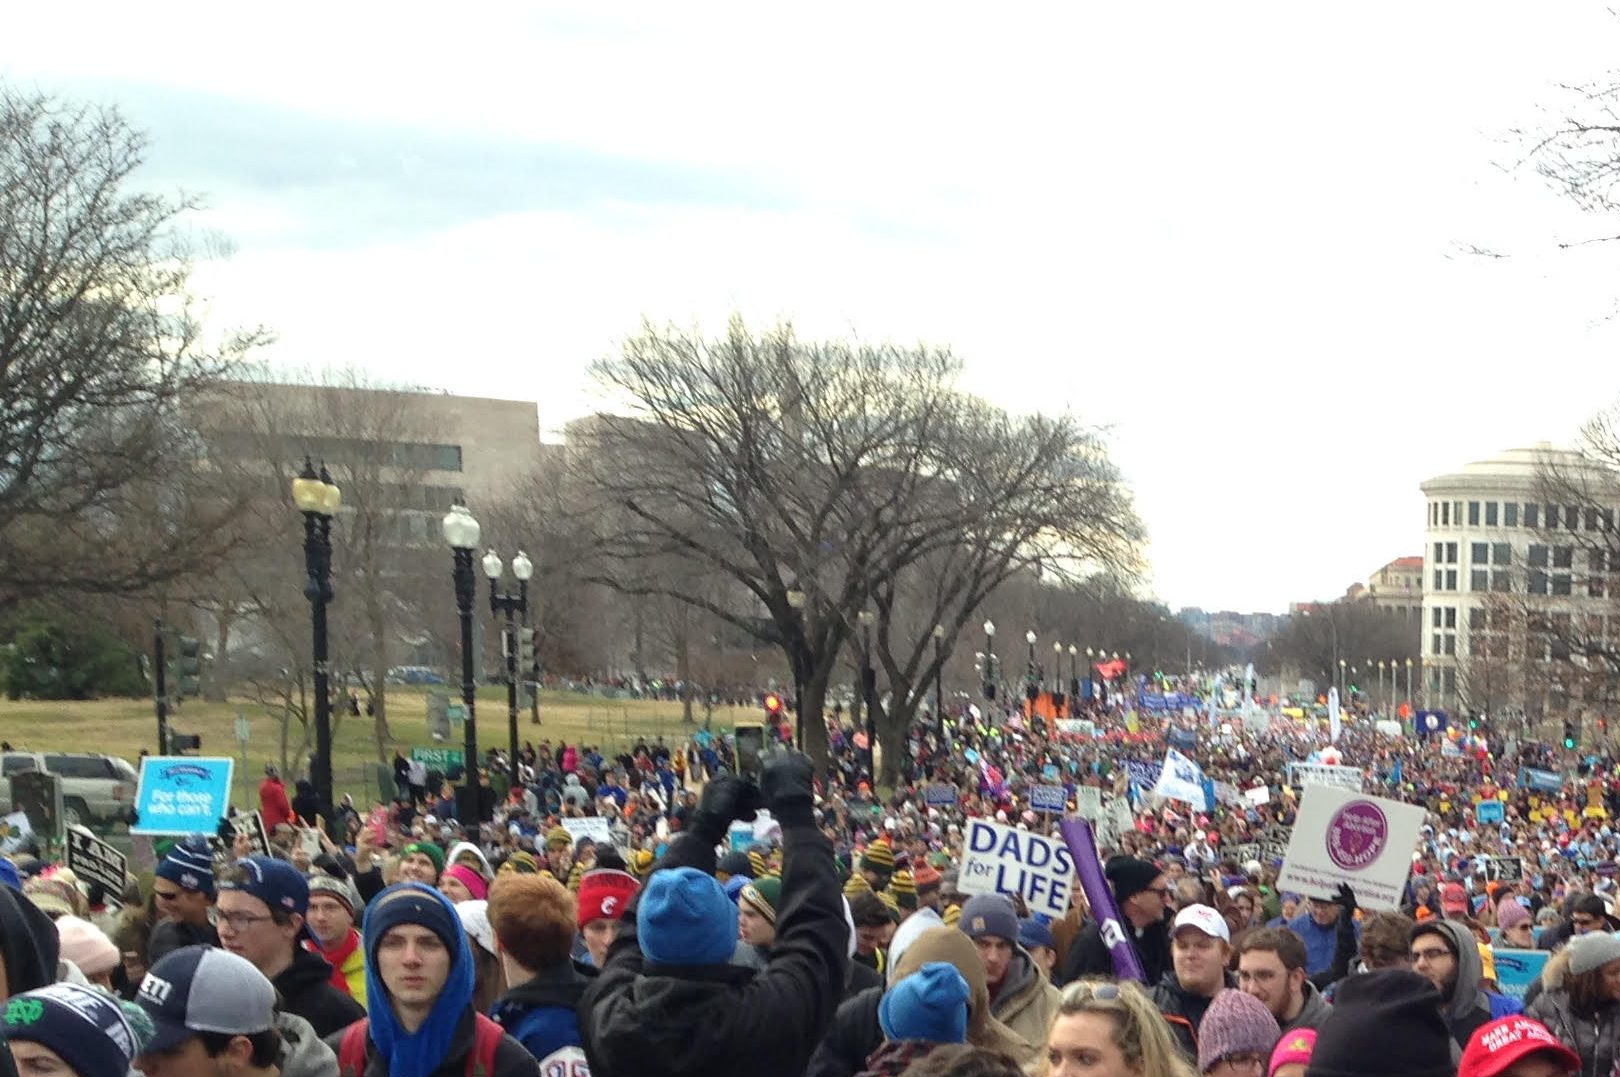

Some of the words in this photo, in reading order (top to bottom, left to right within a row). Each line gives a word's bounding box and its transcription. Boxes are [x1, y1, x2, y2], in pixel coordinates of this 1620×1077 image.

[412, 746, 450, 763] FIRST
[151, 788, 175, 803] For
[176, 790, 213, 804] those
[970, 823, 1072, 877] DADS
[964, 857, 993, 877] for
[995, 864, 1067, 912] LIFE
[1481, 1023, 1510, 1047] MAKE
[1488, 1030, 1523, 1054] GREAT
